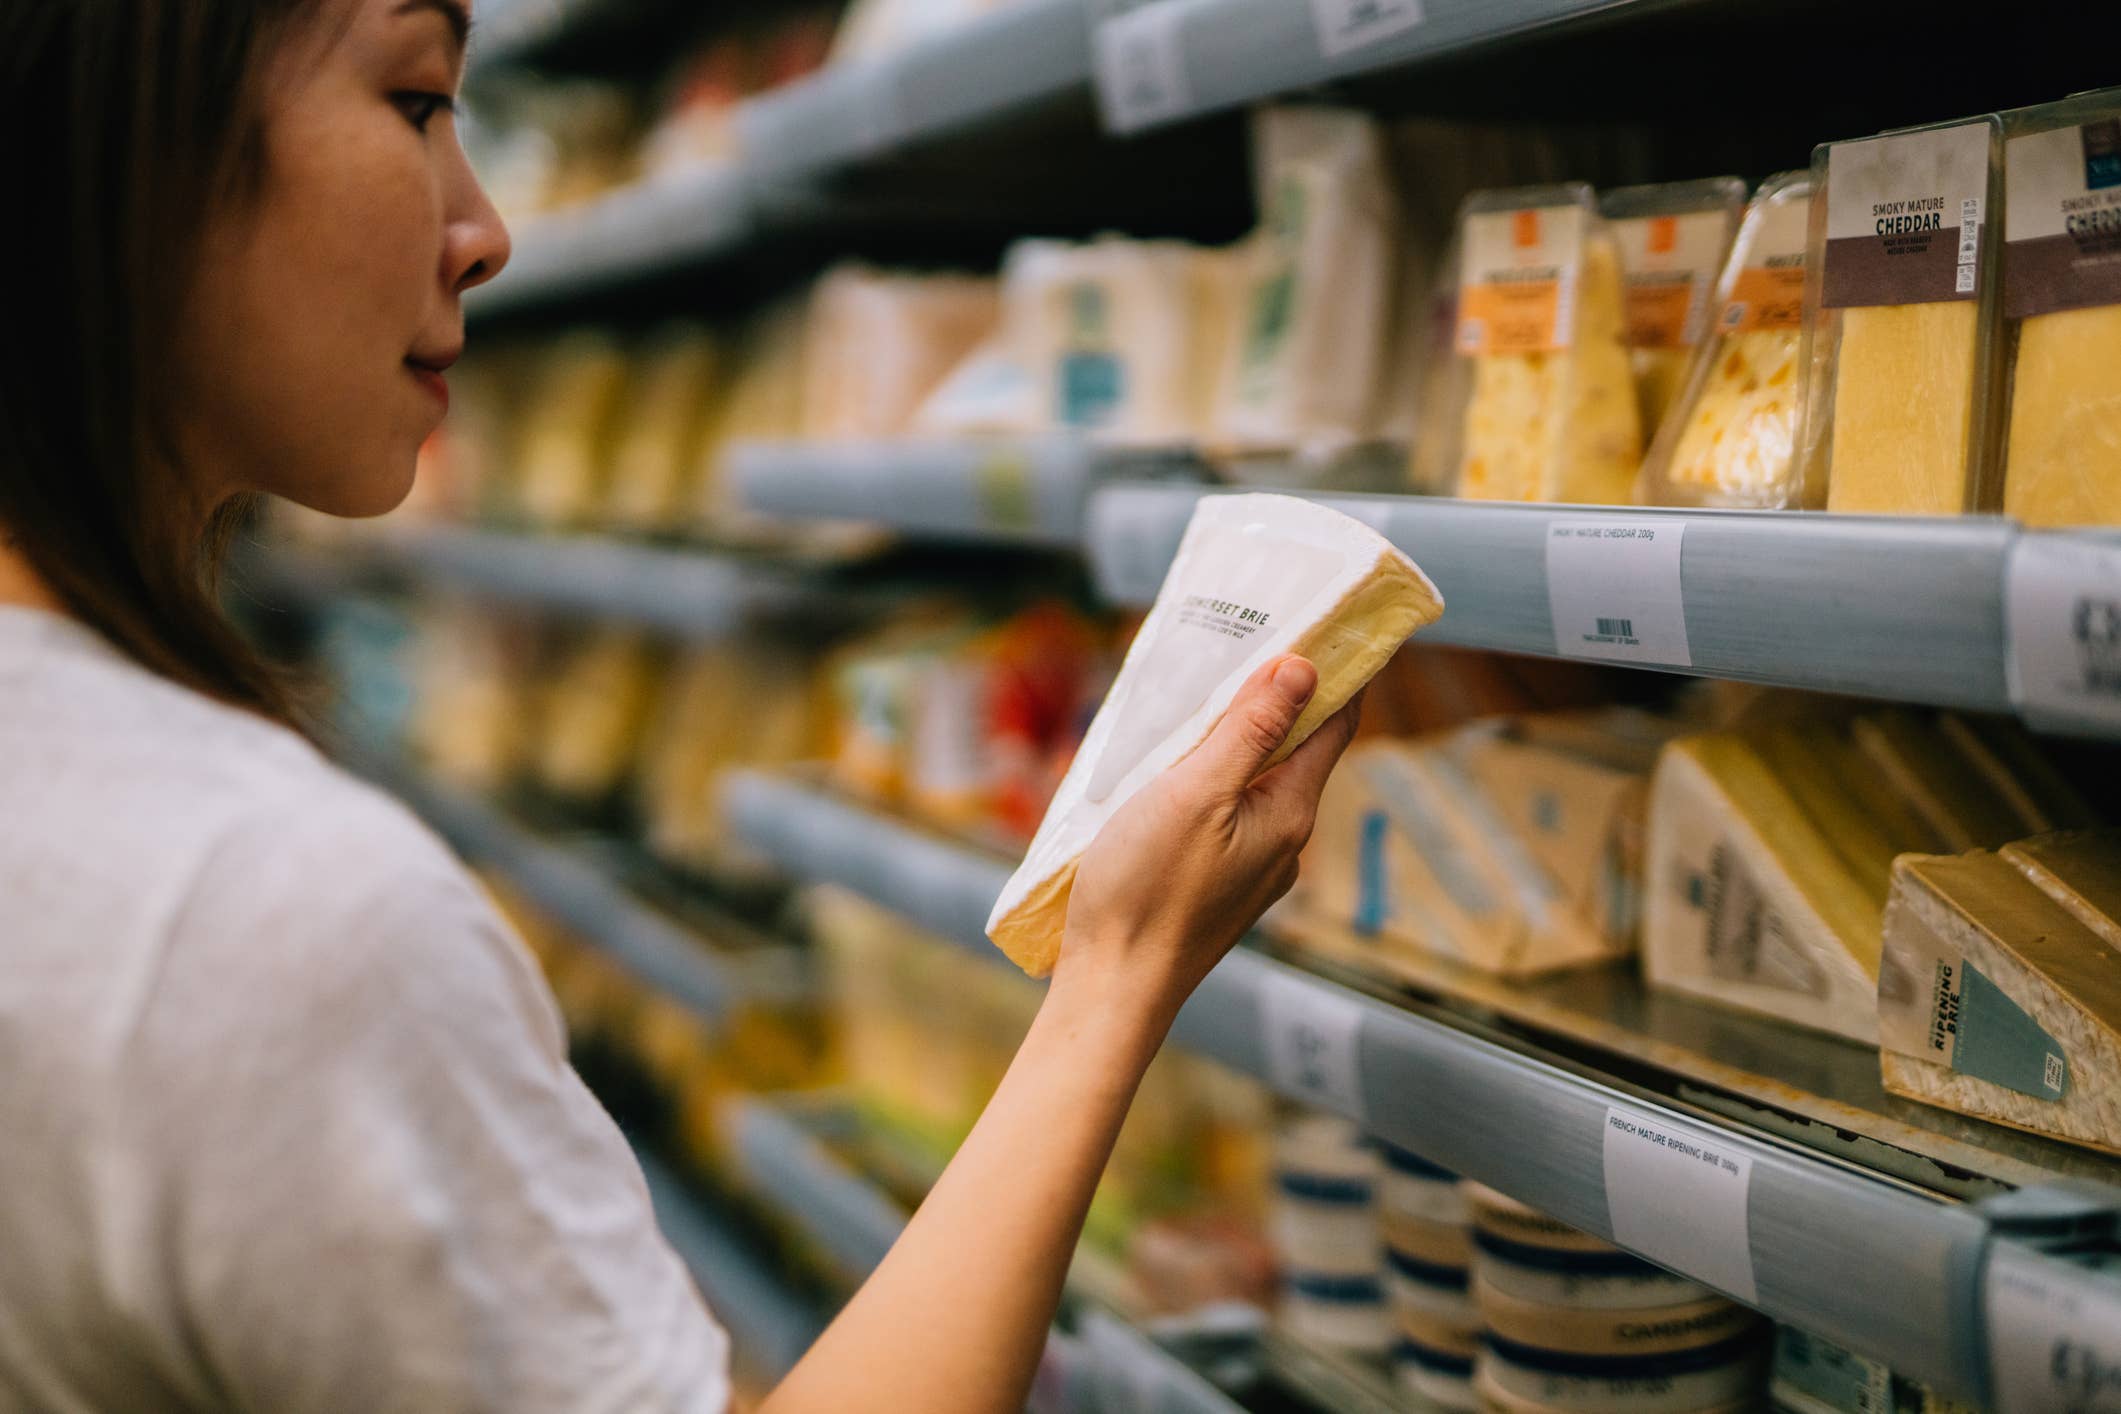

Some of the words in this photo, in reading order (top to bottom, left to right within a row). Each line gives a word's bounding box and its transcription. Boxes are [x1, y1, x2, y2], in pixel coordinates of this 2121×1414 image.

[1872, 201, 1905, 216] SMOKY
[1907, 197, 1944, 213] MATURE
[1876, 213, 1942, 236] CHEDDAR
[1603, 528, 1636, 539] CHEDDAR
[1637, 529, 1655, 541] 200g
[1239, 608, 1270, 626] BRIE
[1934, 965, 1953, 1051] RIPENING
[1946, 992, 1961, 1035] BRIE
[1609, 1116, 1636, 1134] FRENCH
[1637, 1128, 1666, 1146] MATURE
[1667, 1138, 1701, 1159] RIPENING
[1702, 1151, 1720, 1167] BRIE
